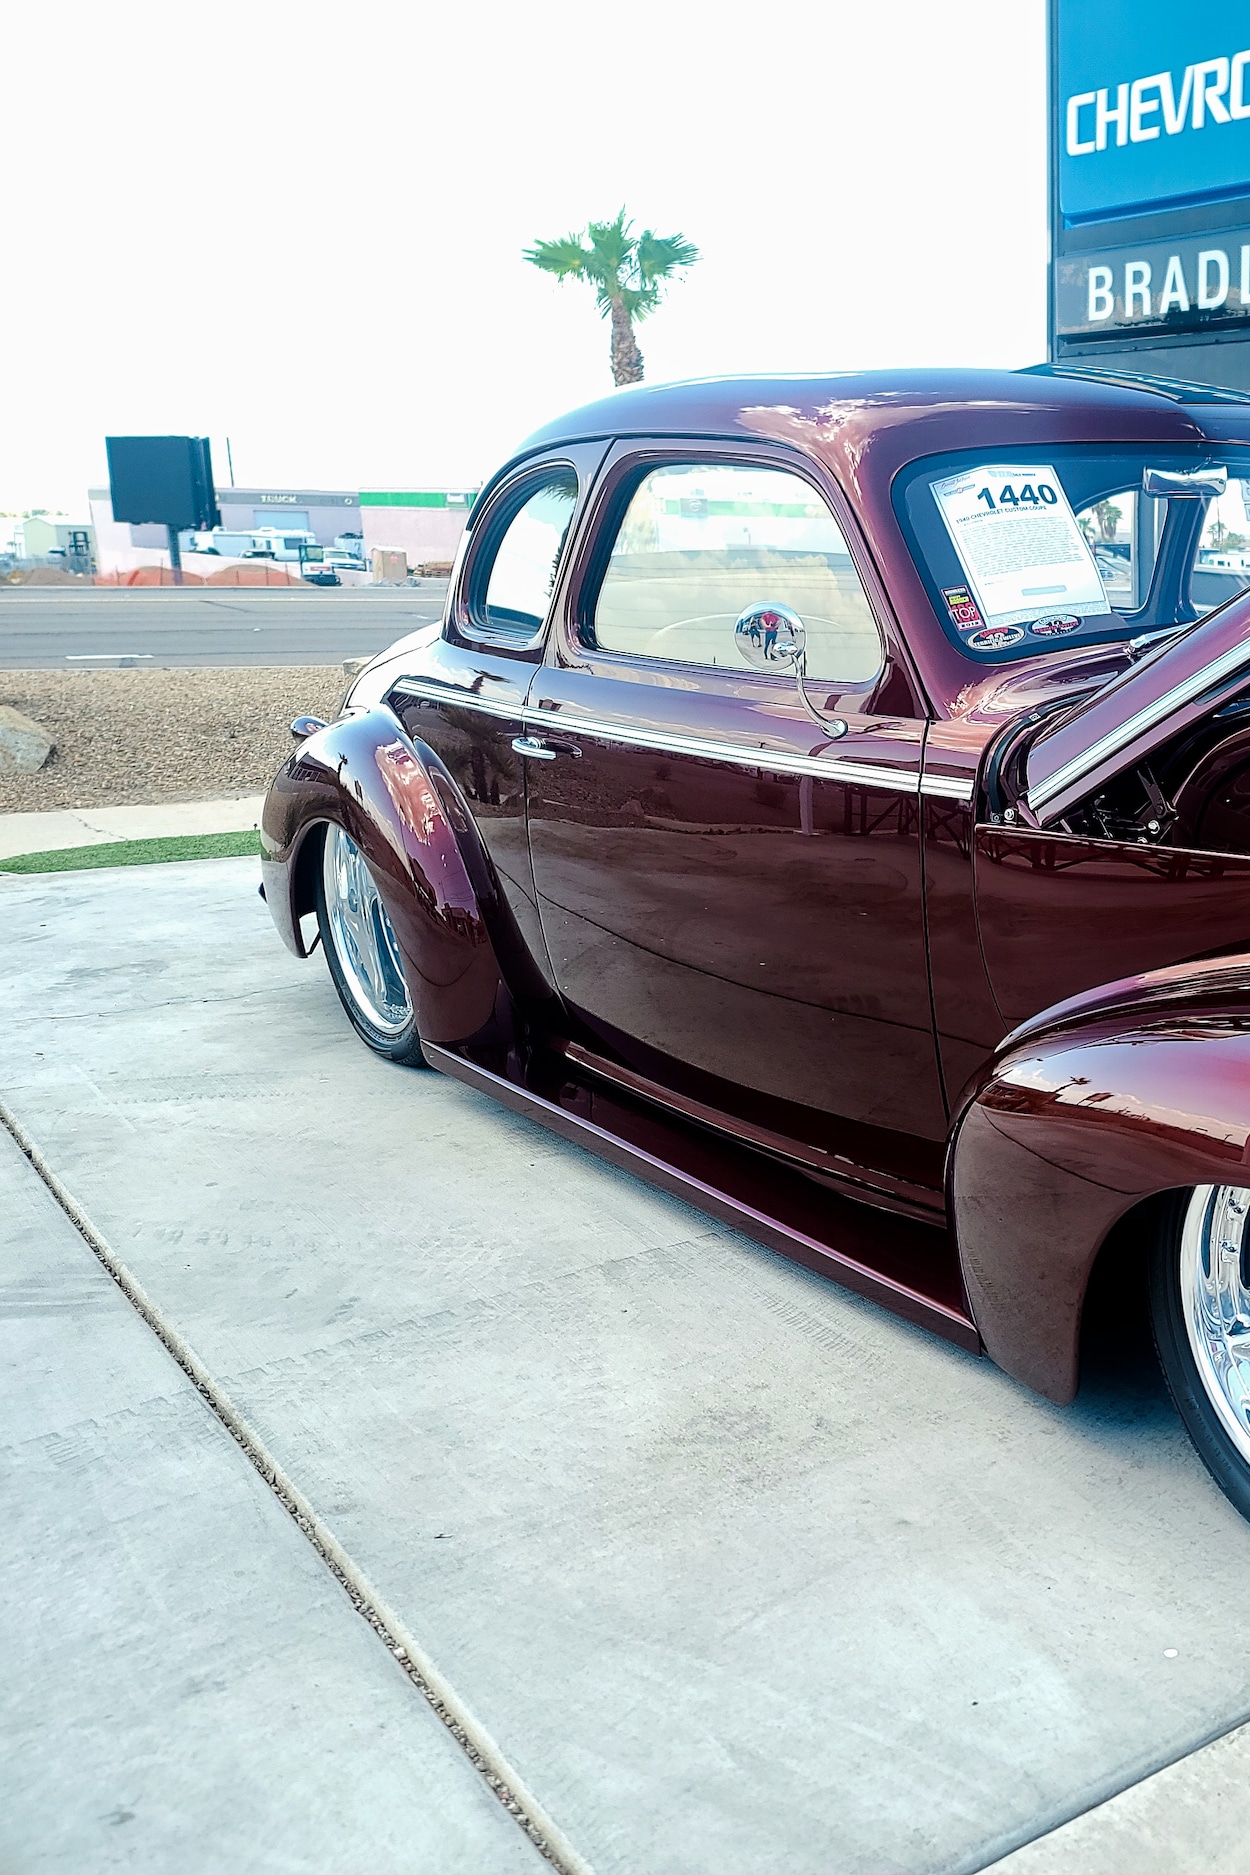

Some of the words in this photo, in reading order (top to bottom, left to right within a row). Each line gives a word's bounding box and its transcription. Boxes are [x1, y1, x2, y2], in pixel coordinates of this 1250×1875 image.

[261, 495, 297, 503] TRUCK
[977, 484, 1058, 509] 1440
[971, 508, 1004, 519] CHEVROLET
[952, 606, 976, 620] TOP
